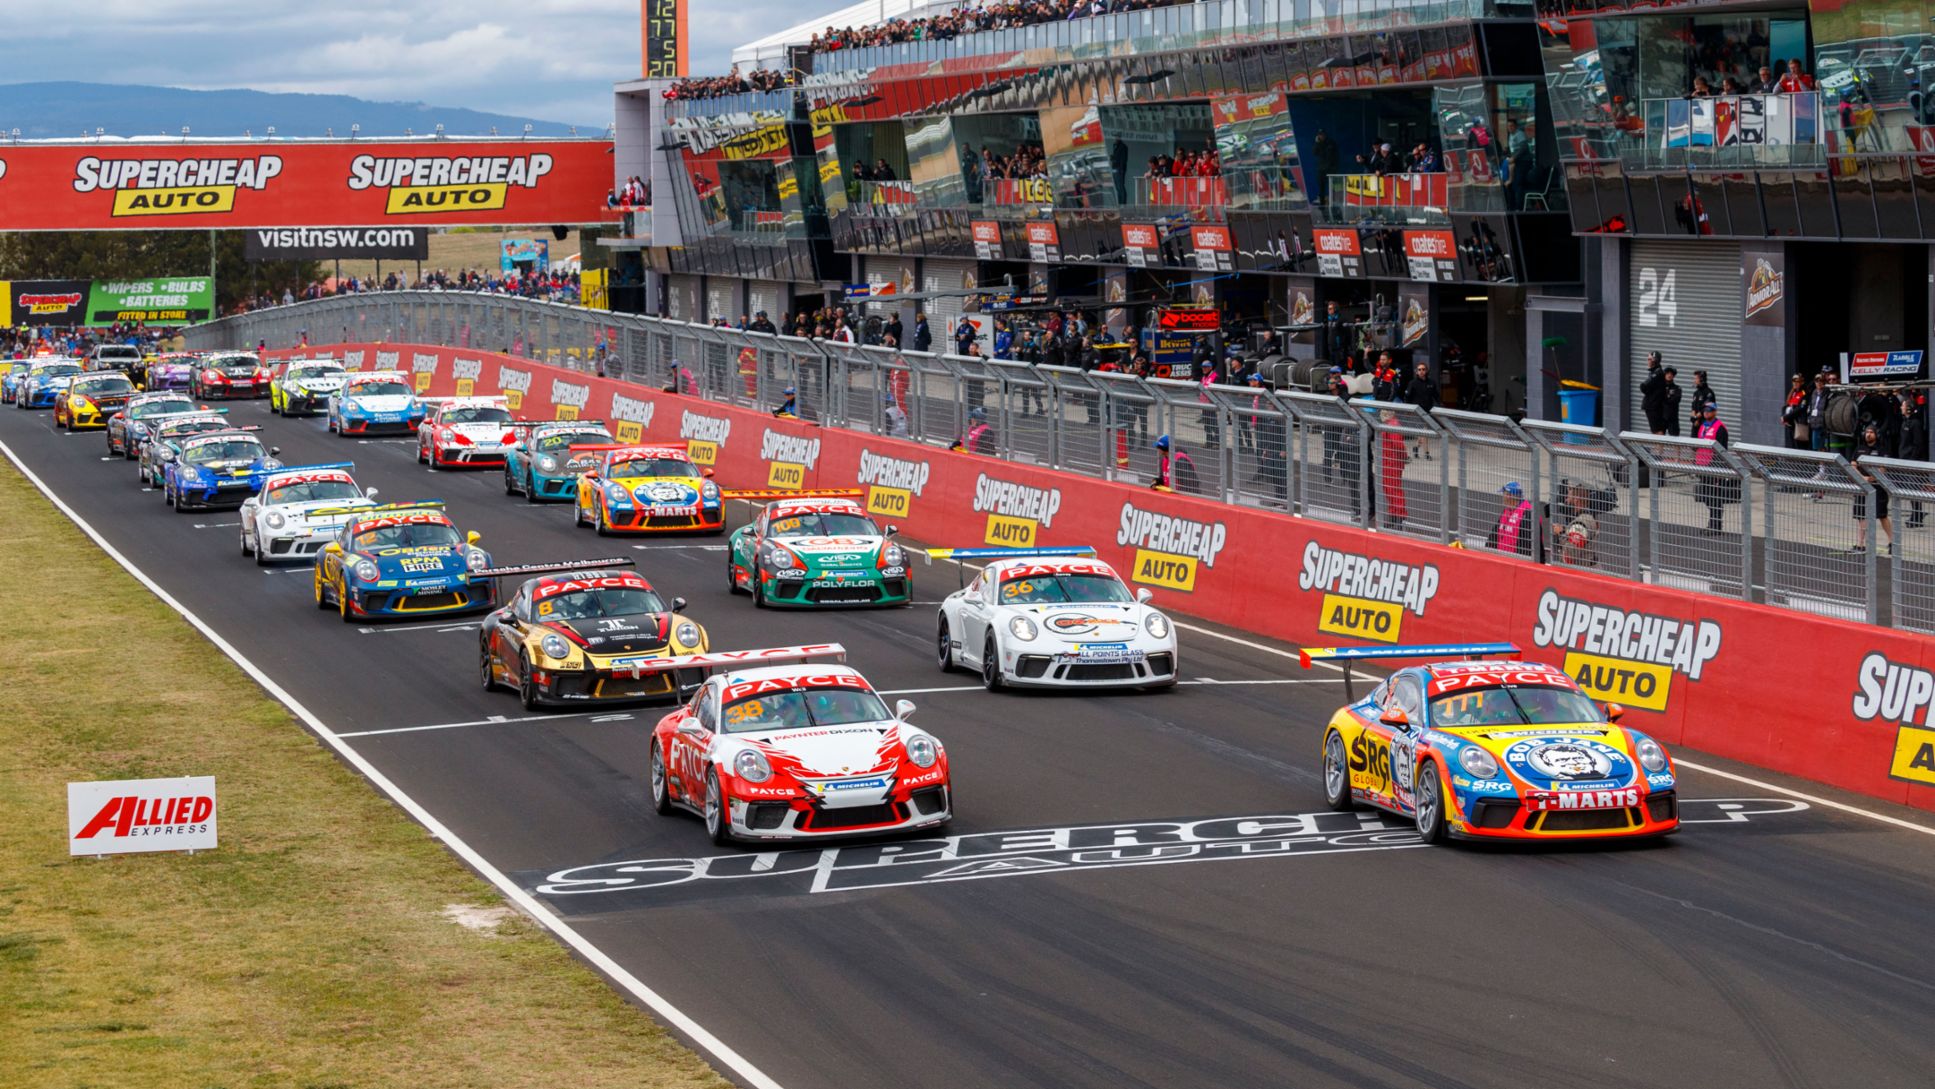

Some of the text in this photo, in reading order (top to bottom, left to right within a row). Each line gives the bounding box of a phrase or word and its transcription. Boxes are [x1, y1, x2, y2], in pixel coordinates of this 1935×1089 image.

[650, 19, 675, 37] 77
[664, 40, 675, 58] 5
[649, 61, 675, 78] 20
[74, 155, 282, 191] SUPERCHEAP
[348, 153, 553, 189] SUPERCHEAP
[128, 190, 220, 209] AUTO
[402, 188, 492, 206] AUTO
[258, 226, 415, 248] visitnsw.com
[108, 281, 206, 293] WIPERS BULBS
[126, 295, 188, 306] BATTERIES
[1639, 267, 1677, 328] 24
[148, 311, 158, 319] IN
[160, 311, 187, 319] STORE
[1180, 313, 1218, 322] boost
[610, 391, 654, 428] SUPERCHEAP
[619, 426, 639, 439] AUTO
[680, 409, 730, 448] SUPERCHEAP
[544, 437, 562, 447] 20
[761, 427, 820, 470] SUPERCHEAP
[615, 452, 686, 462] PAYCE
[691, 447, 713, 461] AUTO
[273, 473, 347, 488] PAYCE
[773, 467, 799, 483] AUTO
[857, 448, 929, 496] SUPERCHEAP
[873, 493, 905, 511] AUTO
[973, 472, 1060, 528] SUPERCHEAP
[645, 506, 697, 516] T-MARTS
[777, 505, 864, 517] PAYCE
[359, 514, 444, 531] PAYCE
[771, 517, 801, 533] 100
[356, 532, 378, 546] 12
[990, 522, 1031, 542] AUTO
[1117, 502, 1225, 568] SUPERCHEAP
[400, 556, 441, 566] RPM
[406, 563, 440, 572] HIRE
[473, 557, 624, 575] Porsche Centre Melbourne
[1008, 565, 1111, 578] PAYCE
[1140, 558, 1189, 584] AUTO
[1300, 540, 1438, 616] SUPERCHEAP
[540, 578, 644, 597] PAYCE
[812, 580, 876, 588] POLYFLOR
[1002, 580, 1034, 598] 36
[538, 601, 553, 616] 8
[1329, 605, 1392, 634] AUTO
[1534, 588, 1721, 680] SUPERCHEAP
[730, 675, 860, 699] PAYCE
[1435, 672, 1570, 692] PAYCE
[1575, 663, 1657, 699] AUTO
[726, 700, 764, 725] 38
[1512, 729, 1597, 737] MICHELIN
[1509, 737, 1623, 763] BOB JANE
[1349, 729, 1390, 792] SRG
[836, 780, 880, 789] MICHELIN
[903, 772, 938, 785] PAYCE
[1472, 779, 1513, 792] SRG
[1571, 782, 1615, 790] MICHELIN
[1648, 774, 1674, 787] SRG
[750, 787, 796, 796] PAYCE
[1533, 789, 1639, 809] T-MARTS
[74, 796, 213, 839] ALLIED
[131, 824, 207, 837] EXPRESS
